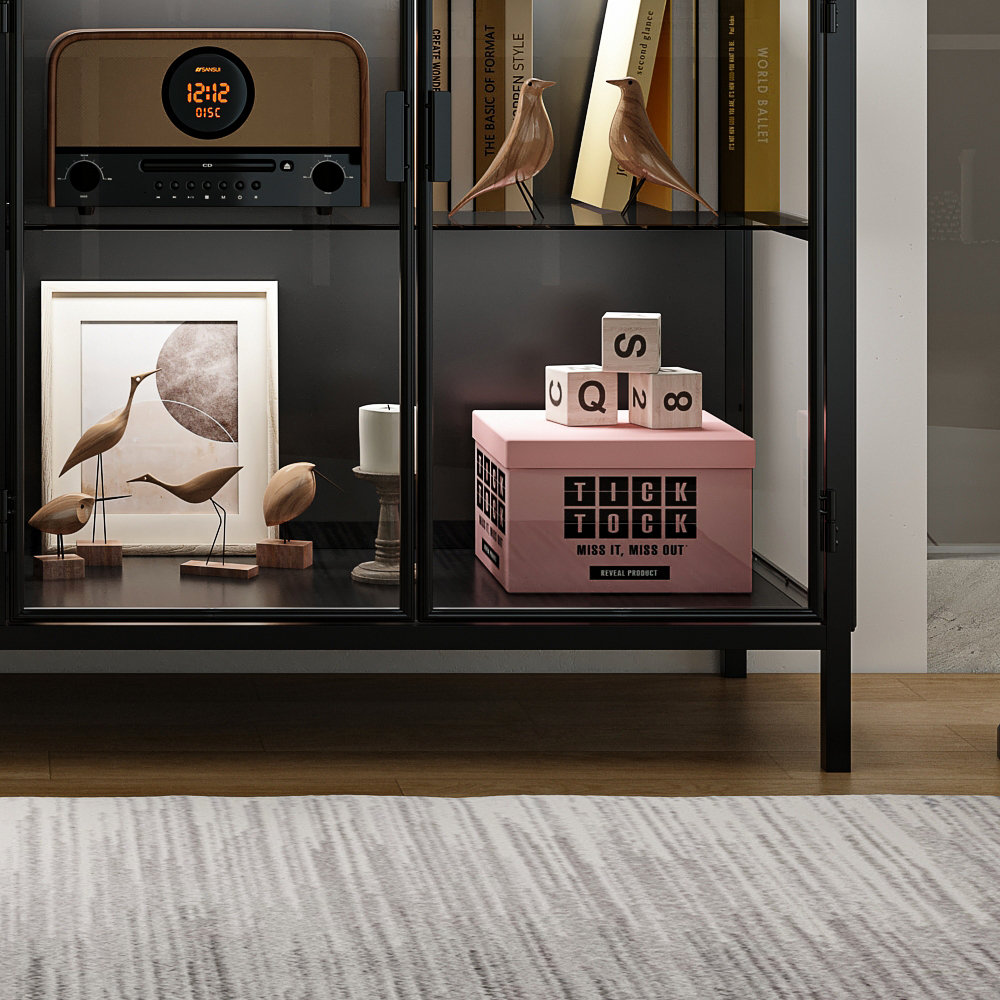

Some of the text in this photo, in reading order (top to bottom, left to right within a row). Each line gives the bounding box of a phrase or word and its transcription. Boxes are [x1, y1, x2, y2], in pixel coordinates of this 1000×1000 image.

[432, 29, 441, 60] CREATE
[512, 33, 525, 71] STYLE
[636, 10, 654, 75] second glance
[187, 82, 230, 103] 12:12
[484, 24, 495, 157] THE BASIC OF FORMAT
[757, 47, 769, 144] WORLD BALLET
[614, 332, 647, 358] S
[578, 380, 607, 414] Q
[663, 391, 693, 412] 8
[572, 481, 689, 502] TICK
[572, 513, 689, 534] TOCK
[576, 544, 685, 557] MISS IT, MISS OUT
[600, 569, 658, 577] REVEAL PRODUCT
